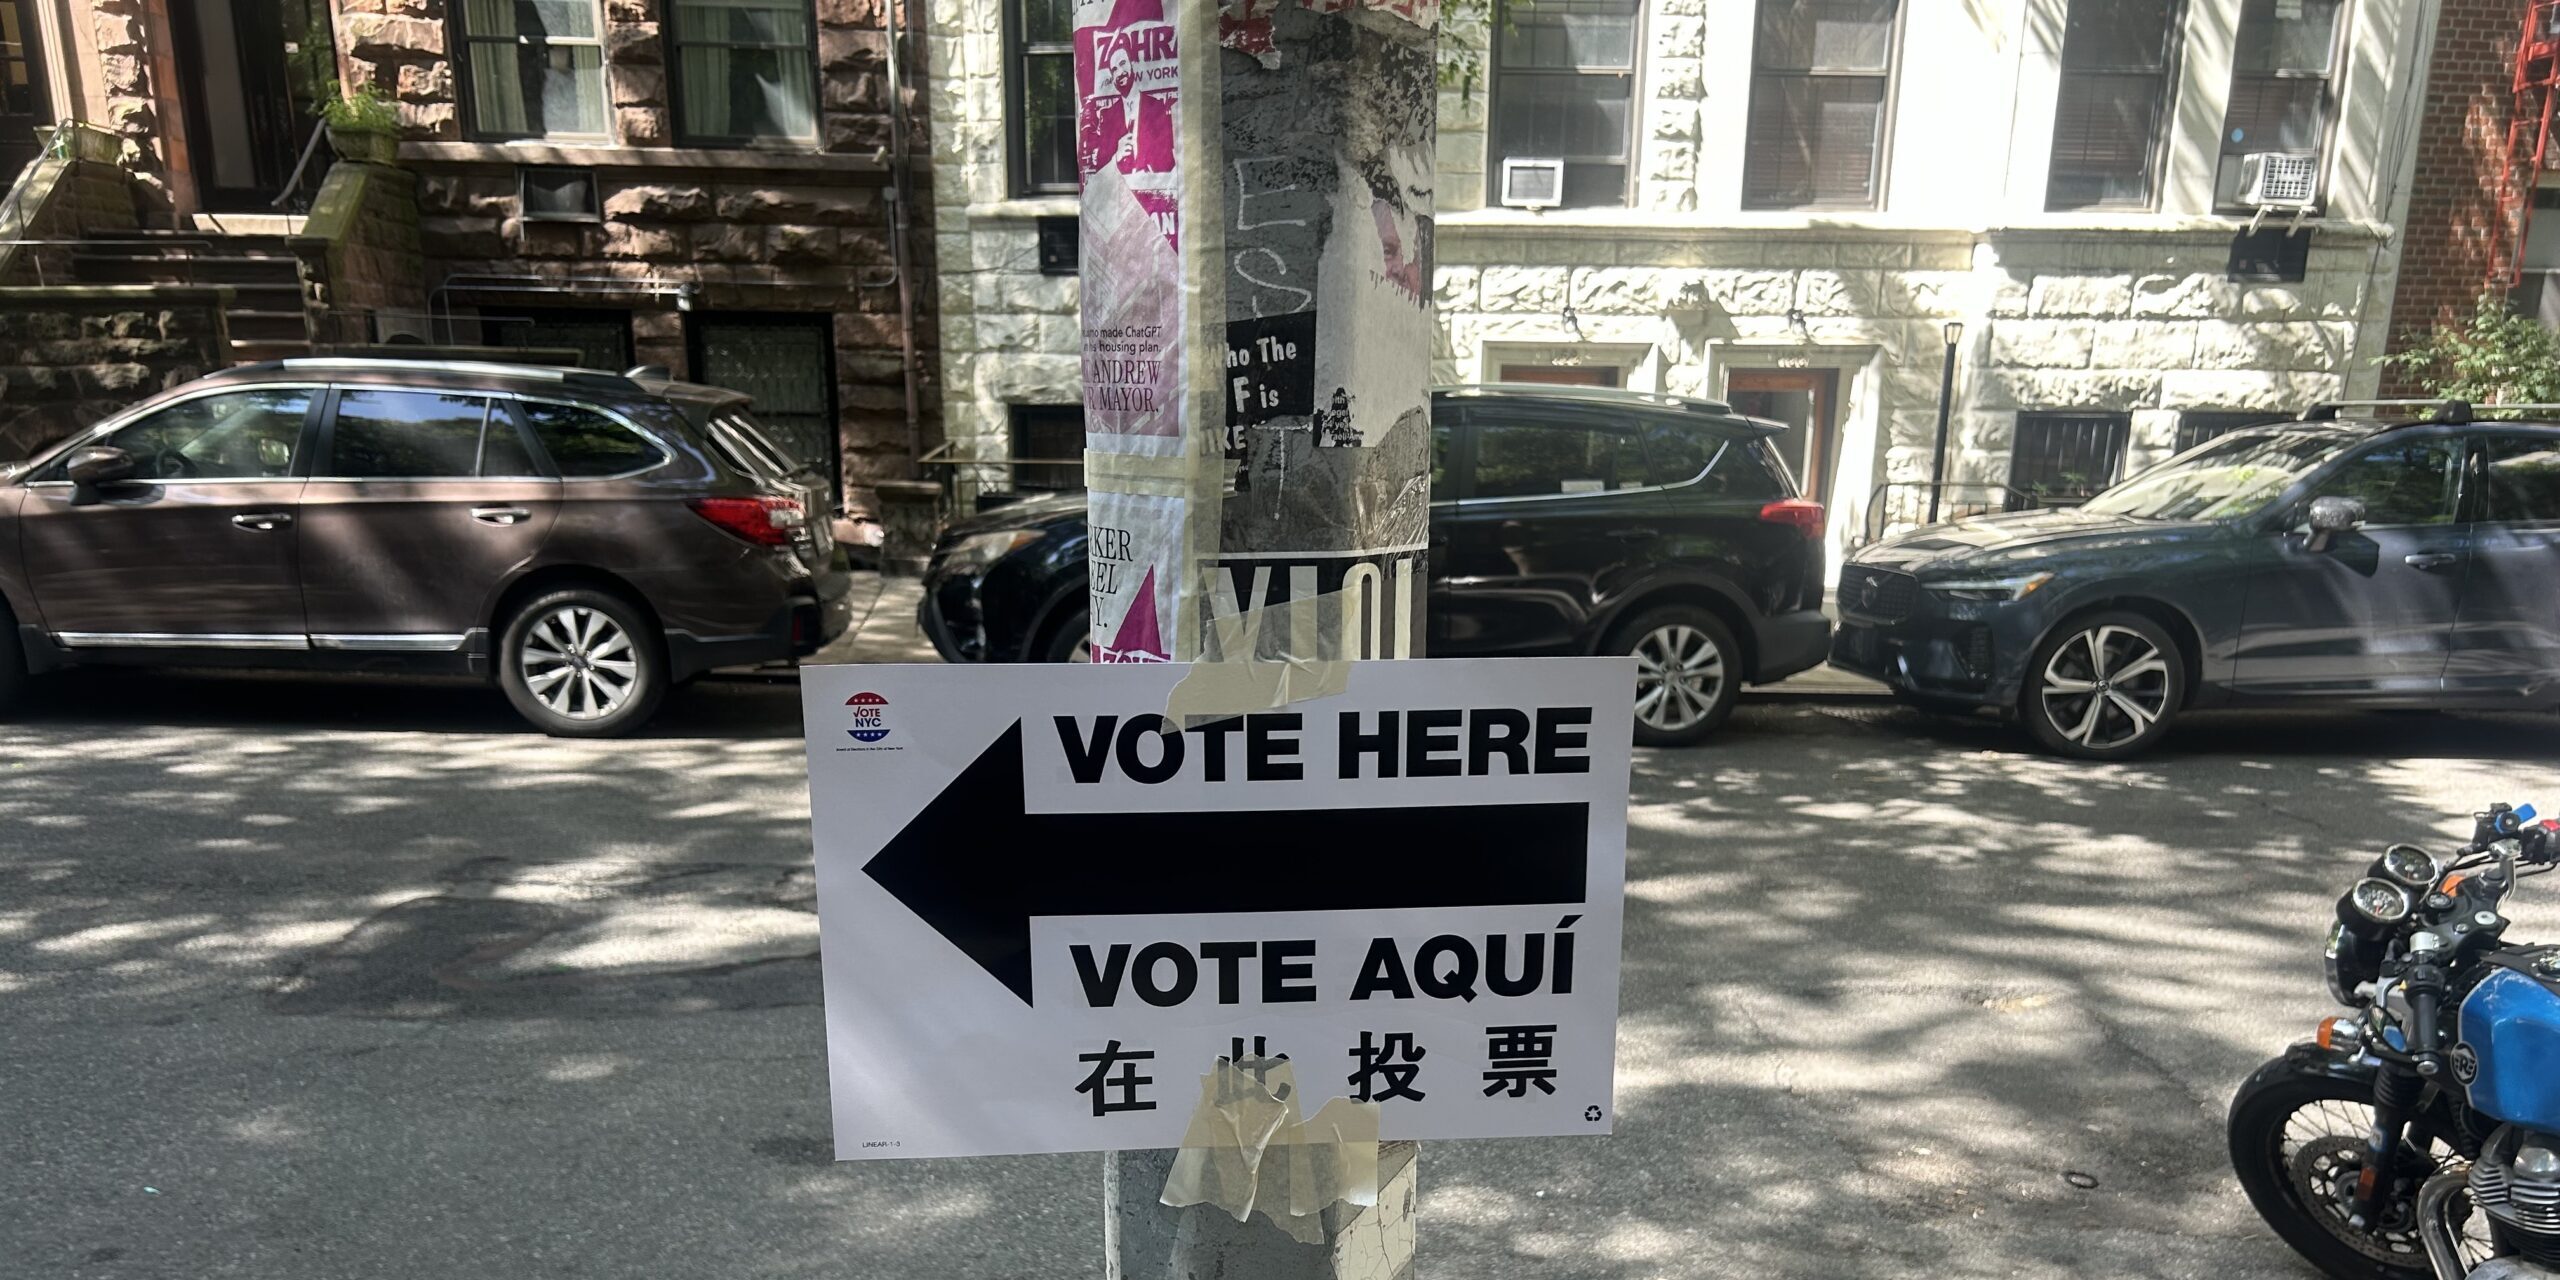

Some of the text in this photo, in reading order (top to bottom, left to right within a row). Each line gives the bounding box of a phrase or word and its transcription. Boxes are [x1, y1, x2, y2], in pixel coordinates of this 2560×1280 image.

[1146, 66, 1179, 81] YORK
[1100, 326, 1124, 339] made
[1125, 326, 1162, 338] ChatGPT
[1099, 340, 1136, 355] housing
[1139, 341, 1162, 356] plan.
[1256, 335, 1297, 363] The
[1093, 359, 1162, 385] ANDREW
[1099, 386, 1160, 413] MAYOR.
[1233, 376, 1280, 413] F is
[855, 717, 881, 728] NYC
[1052, 706, 1593, 785] VOTE HERE
[1068, 914, 1584, 1008] VOTE AQUÍ
